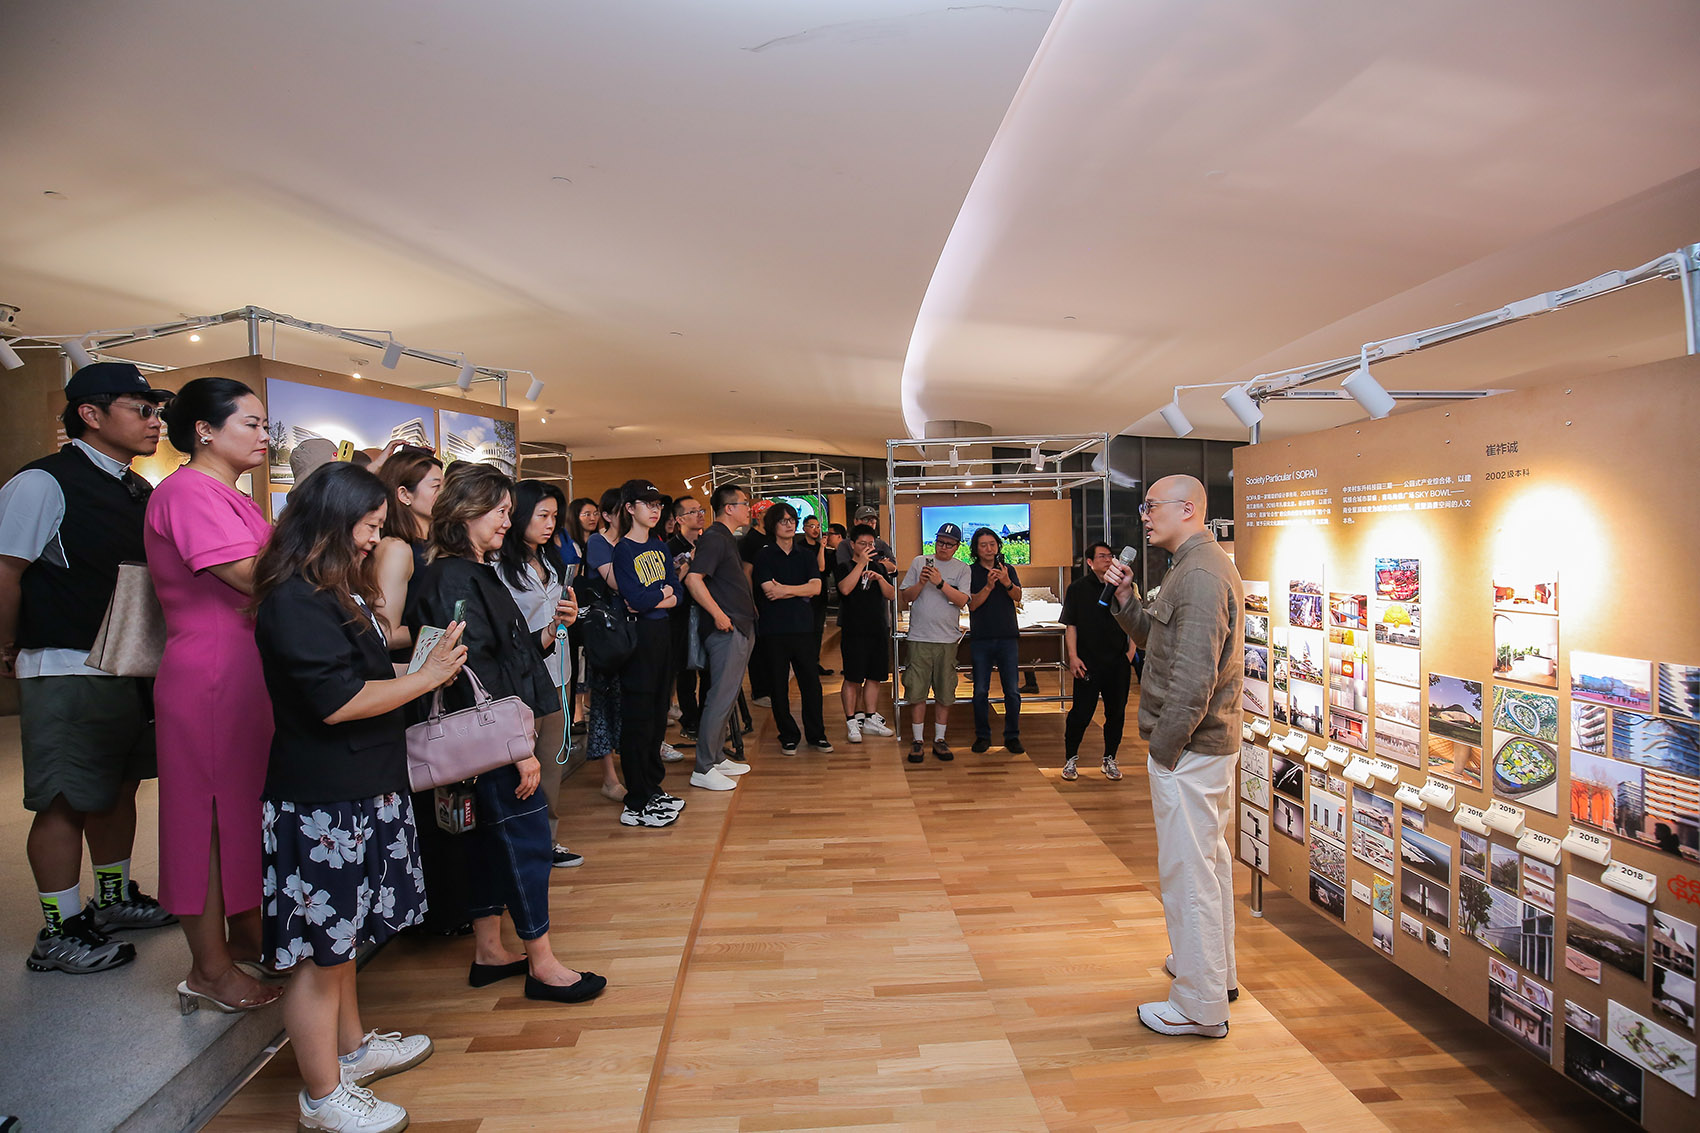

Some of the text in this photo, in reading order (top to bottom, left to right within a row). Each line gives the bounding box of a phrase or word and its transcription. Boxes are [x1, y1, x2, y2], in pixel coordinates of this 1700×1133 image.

[1245, 476, 1265, 485] Society
[1265, 472, 1292, 483] Particular
[945, 525, 953, 533] N
[1433, 780, 1449, 790] 2020
[1499, 804, 1516, 815] 2019
[1533, 833, 1551, 845] 2017
[1579, 832, 1600, 844] 2018
[1621, 866, 1644, 880] 2018
